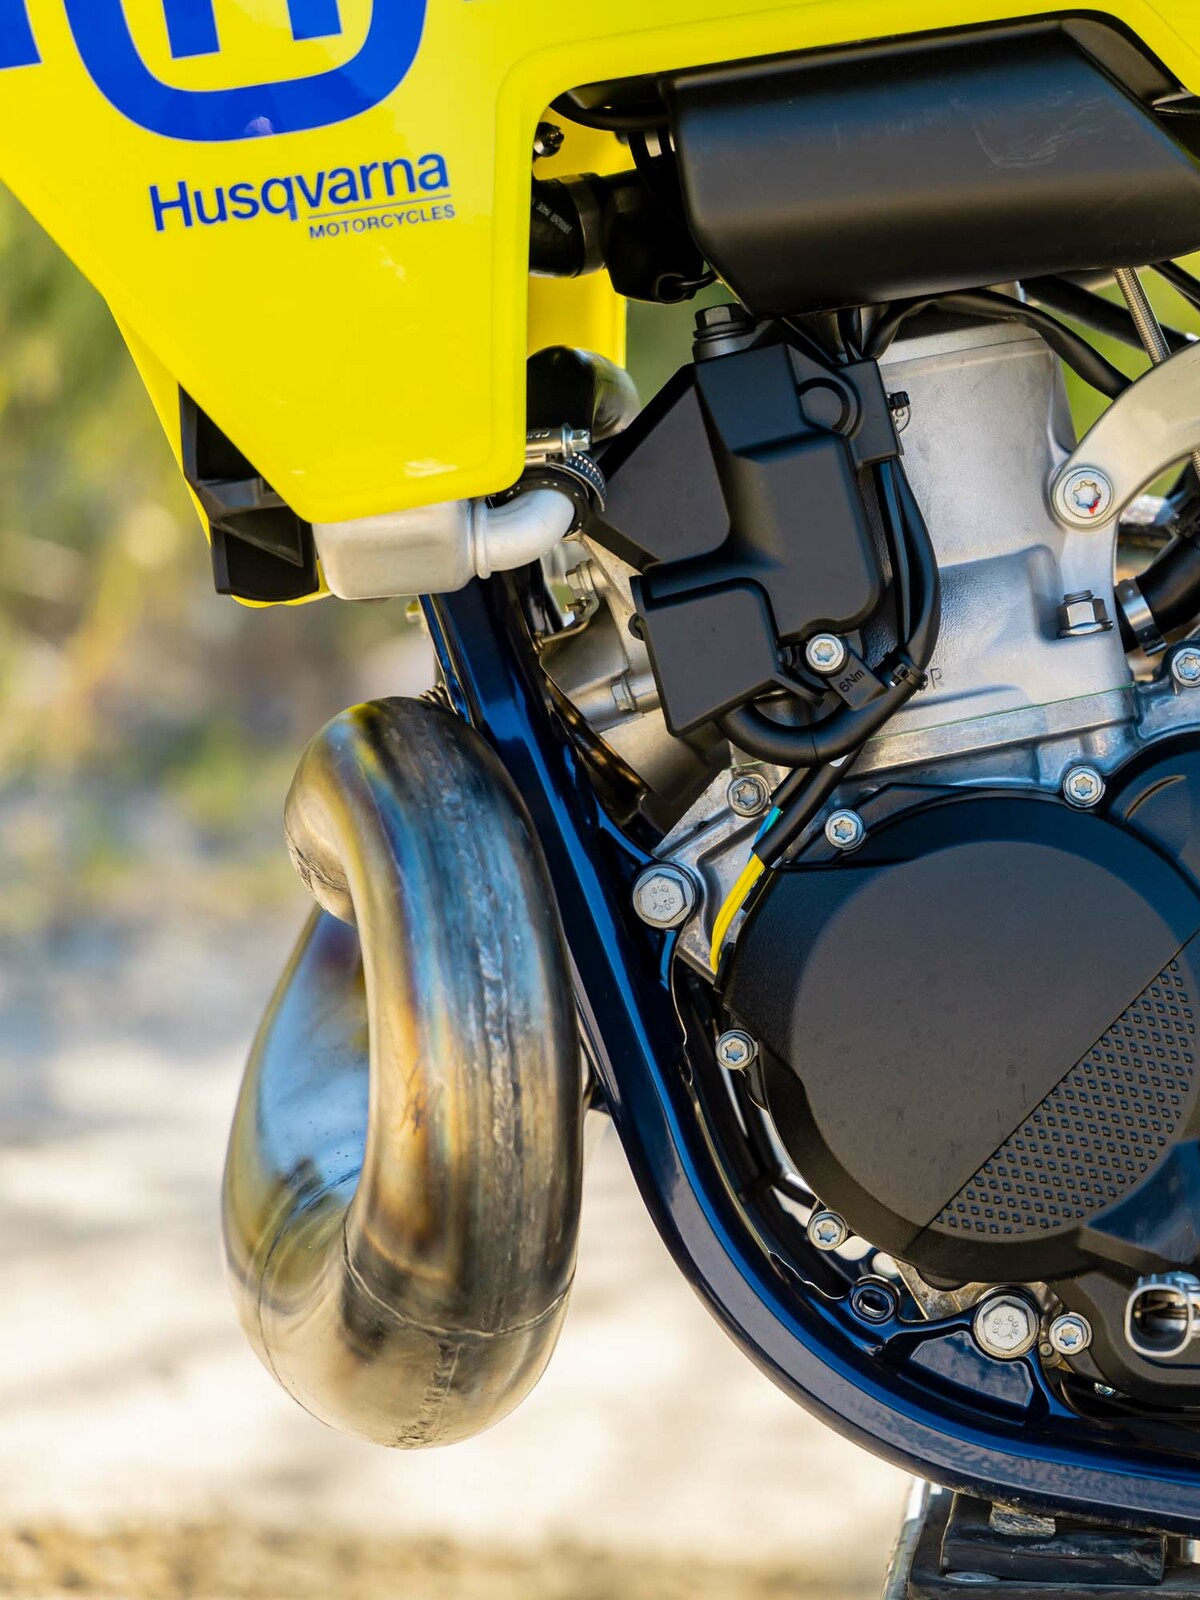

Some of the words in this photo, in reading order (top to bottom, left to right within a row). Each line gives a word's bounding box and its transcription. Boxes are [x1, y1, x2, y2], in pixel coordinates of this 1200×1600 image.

[149, 153, 449, 232] Husqvarna
[309, 204, 455, 239] MOTORCYCLES
[838, 669, 865, 693] 6Nm
